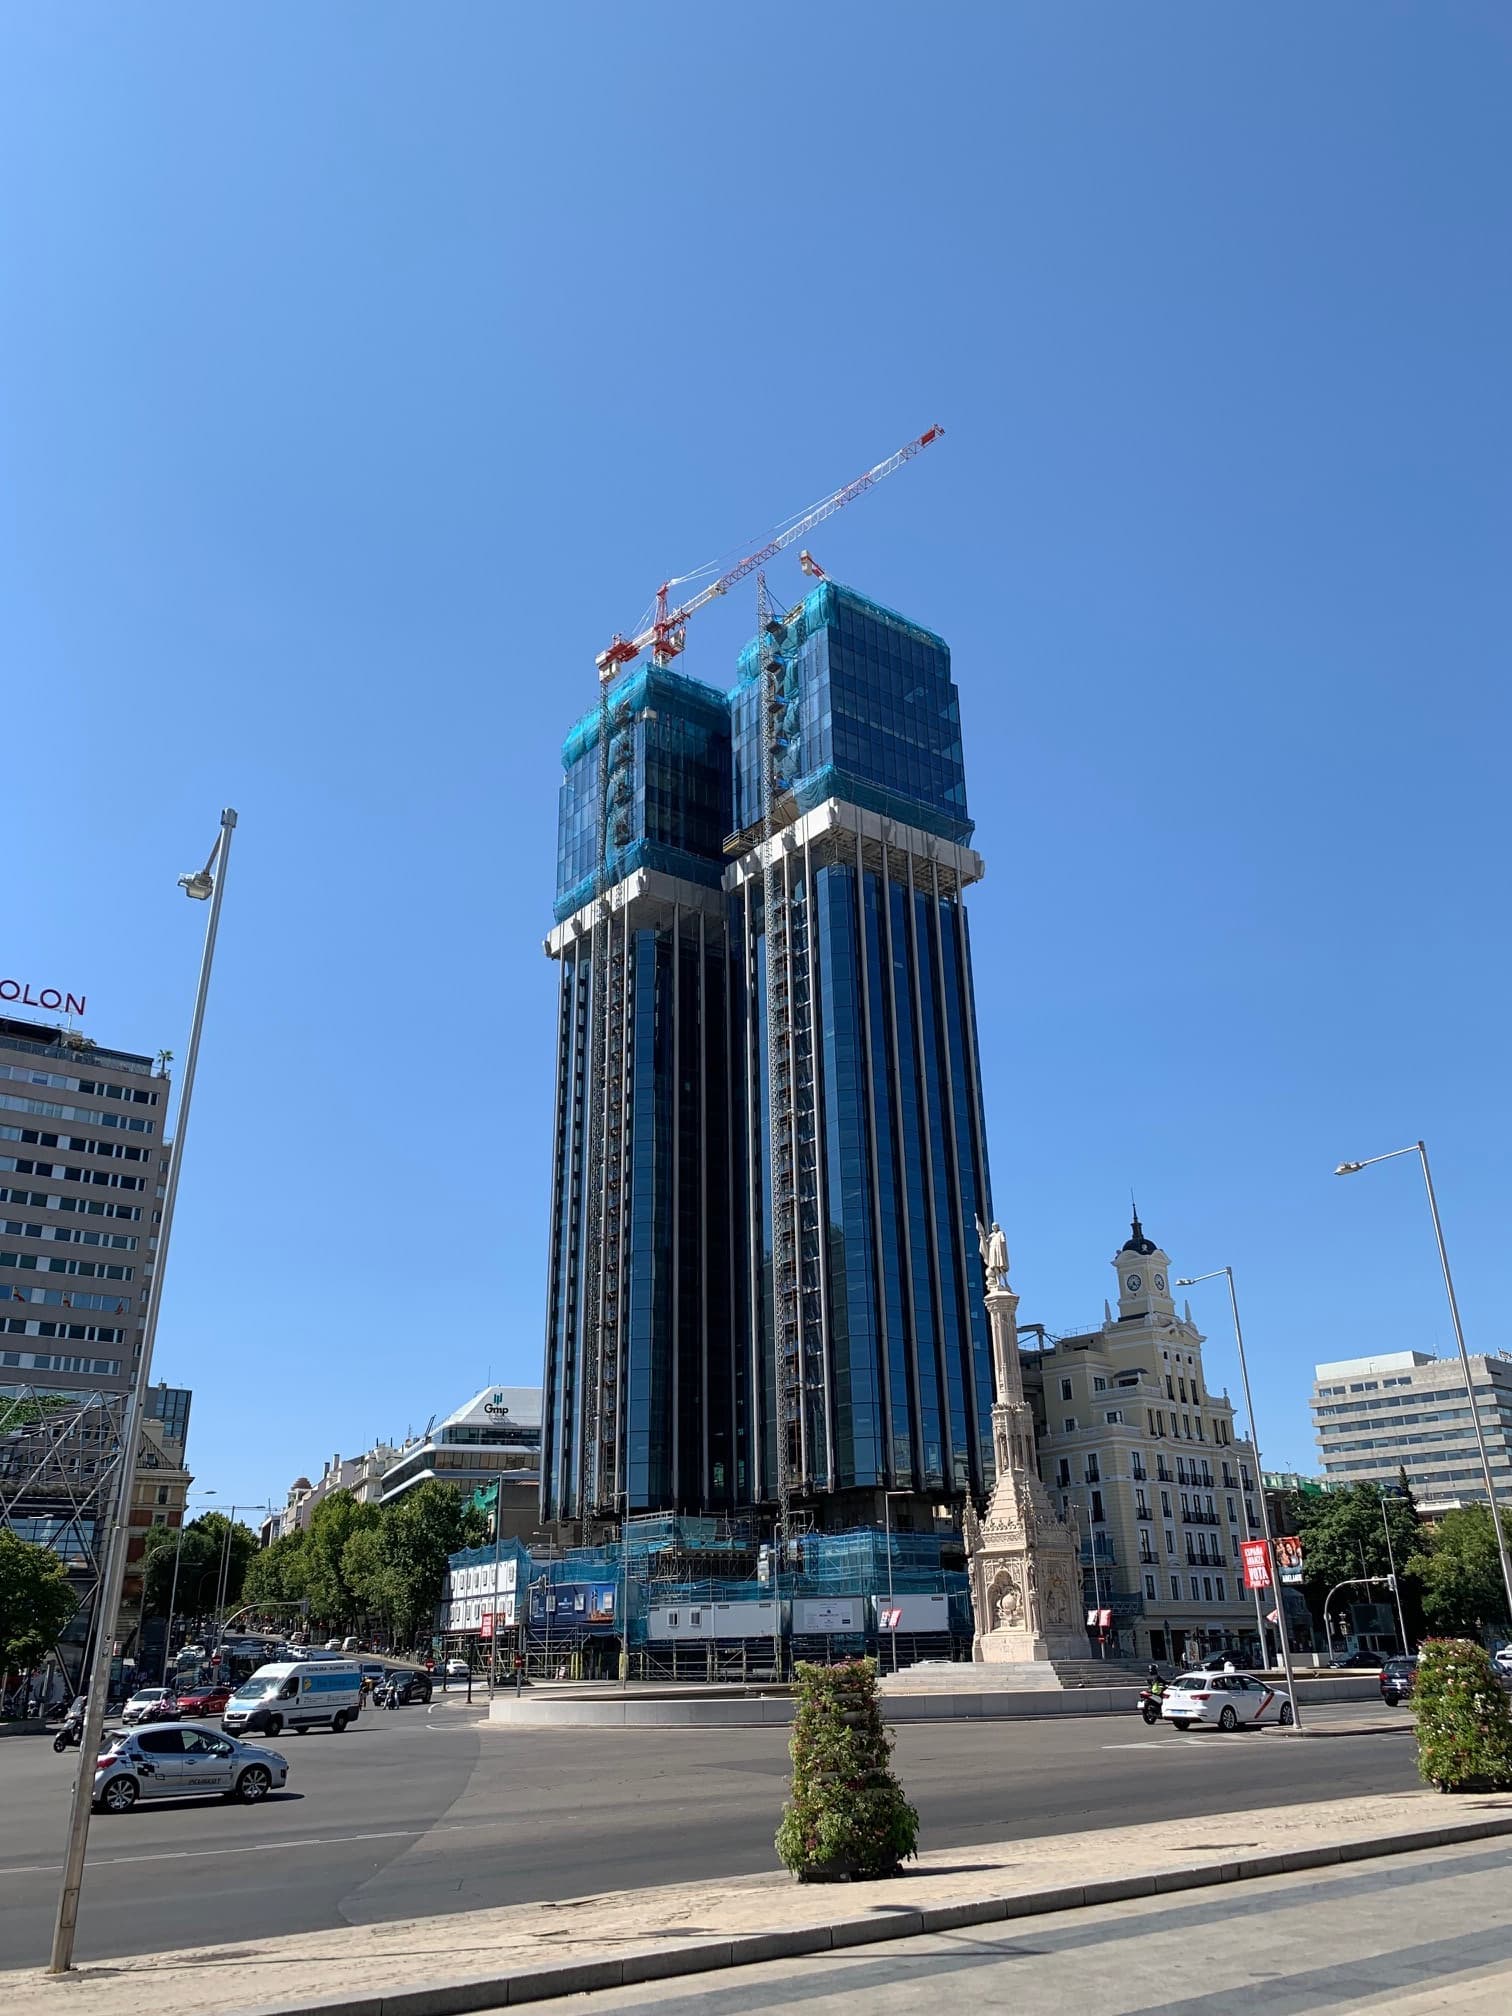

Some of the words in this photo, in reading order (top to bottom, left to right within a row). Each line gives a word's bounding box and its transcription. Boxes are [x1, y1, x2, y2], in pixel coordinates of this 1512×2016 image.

[0, 979, 86, 1015] OLON
[484, 1403, 509, 1416] Gmp
[1248, 1566, 1268, 1580] VOTA
